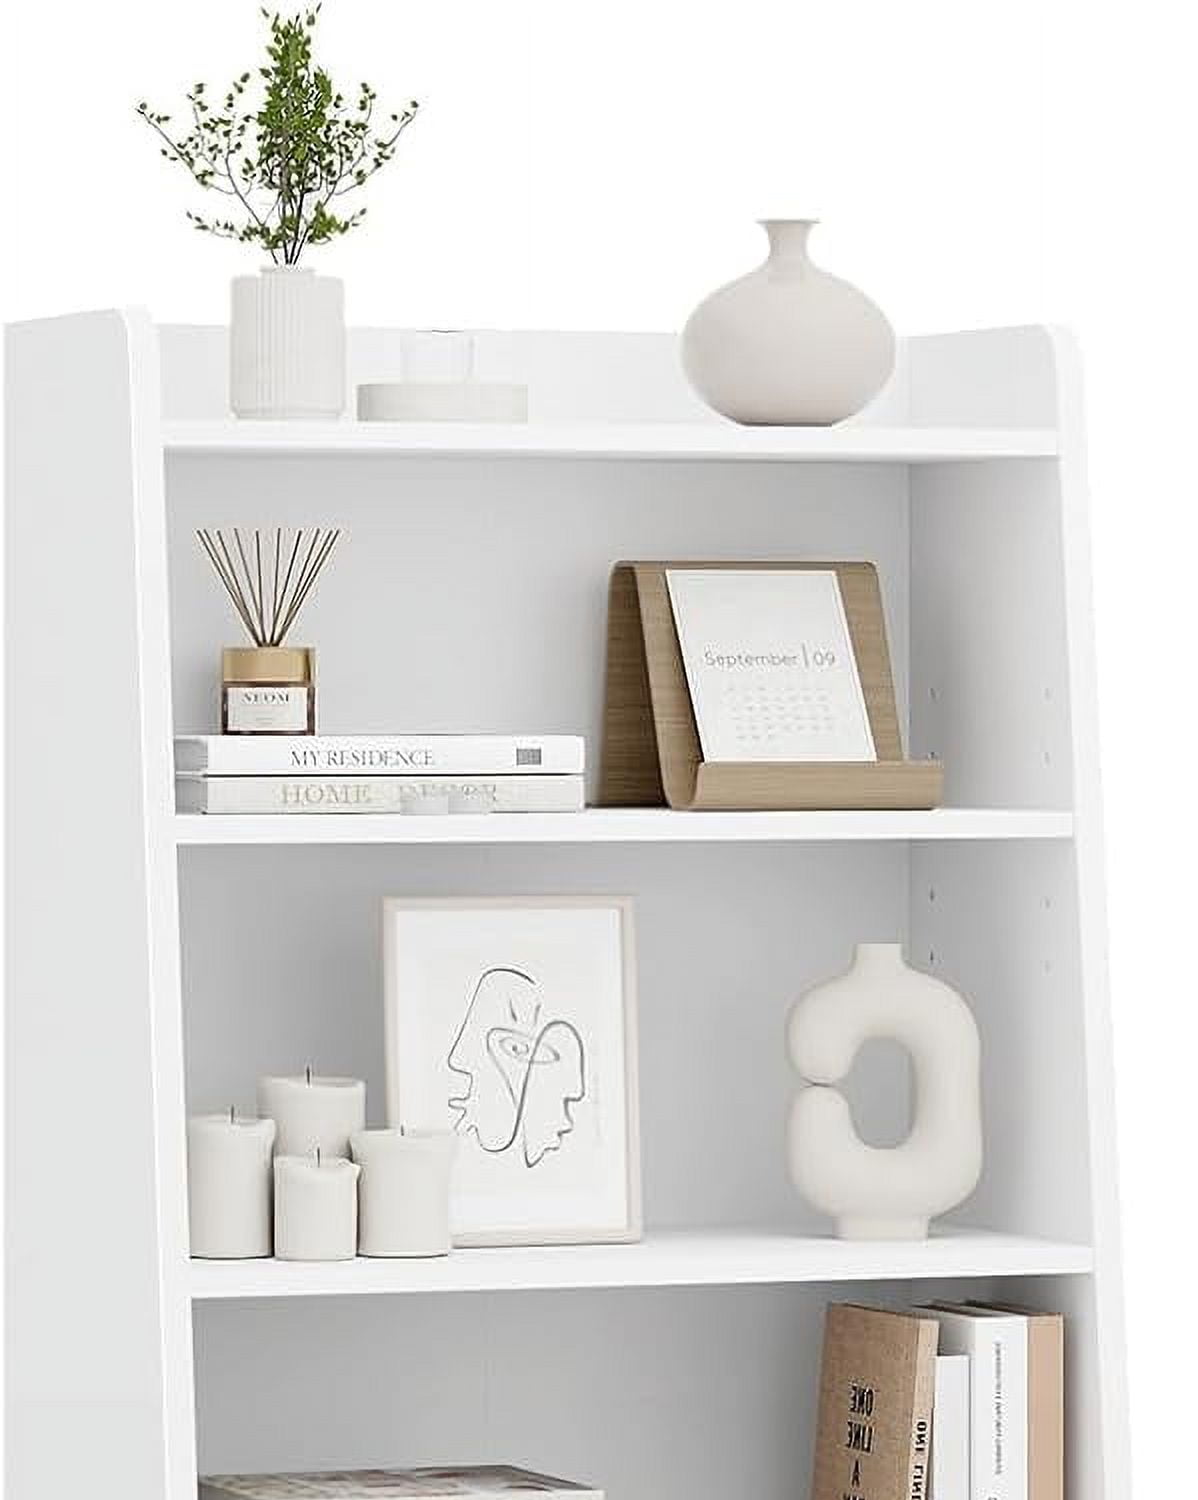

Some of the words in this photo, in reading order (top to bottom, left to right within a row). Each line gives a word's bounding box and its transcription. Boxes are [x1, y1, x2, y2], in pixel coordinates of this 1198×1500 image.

[703, 651, 799, 669] September
[812, 651, 837, 667] 09
[241, 692, 290, 704] NEOM
[291, 750, 320, 767] MY
[326, 749, 434, 767] RESIDENCE
[281, 783, 372, 804] HOME
